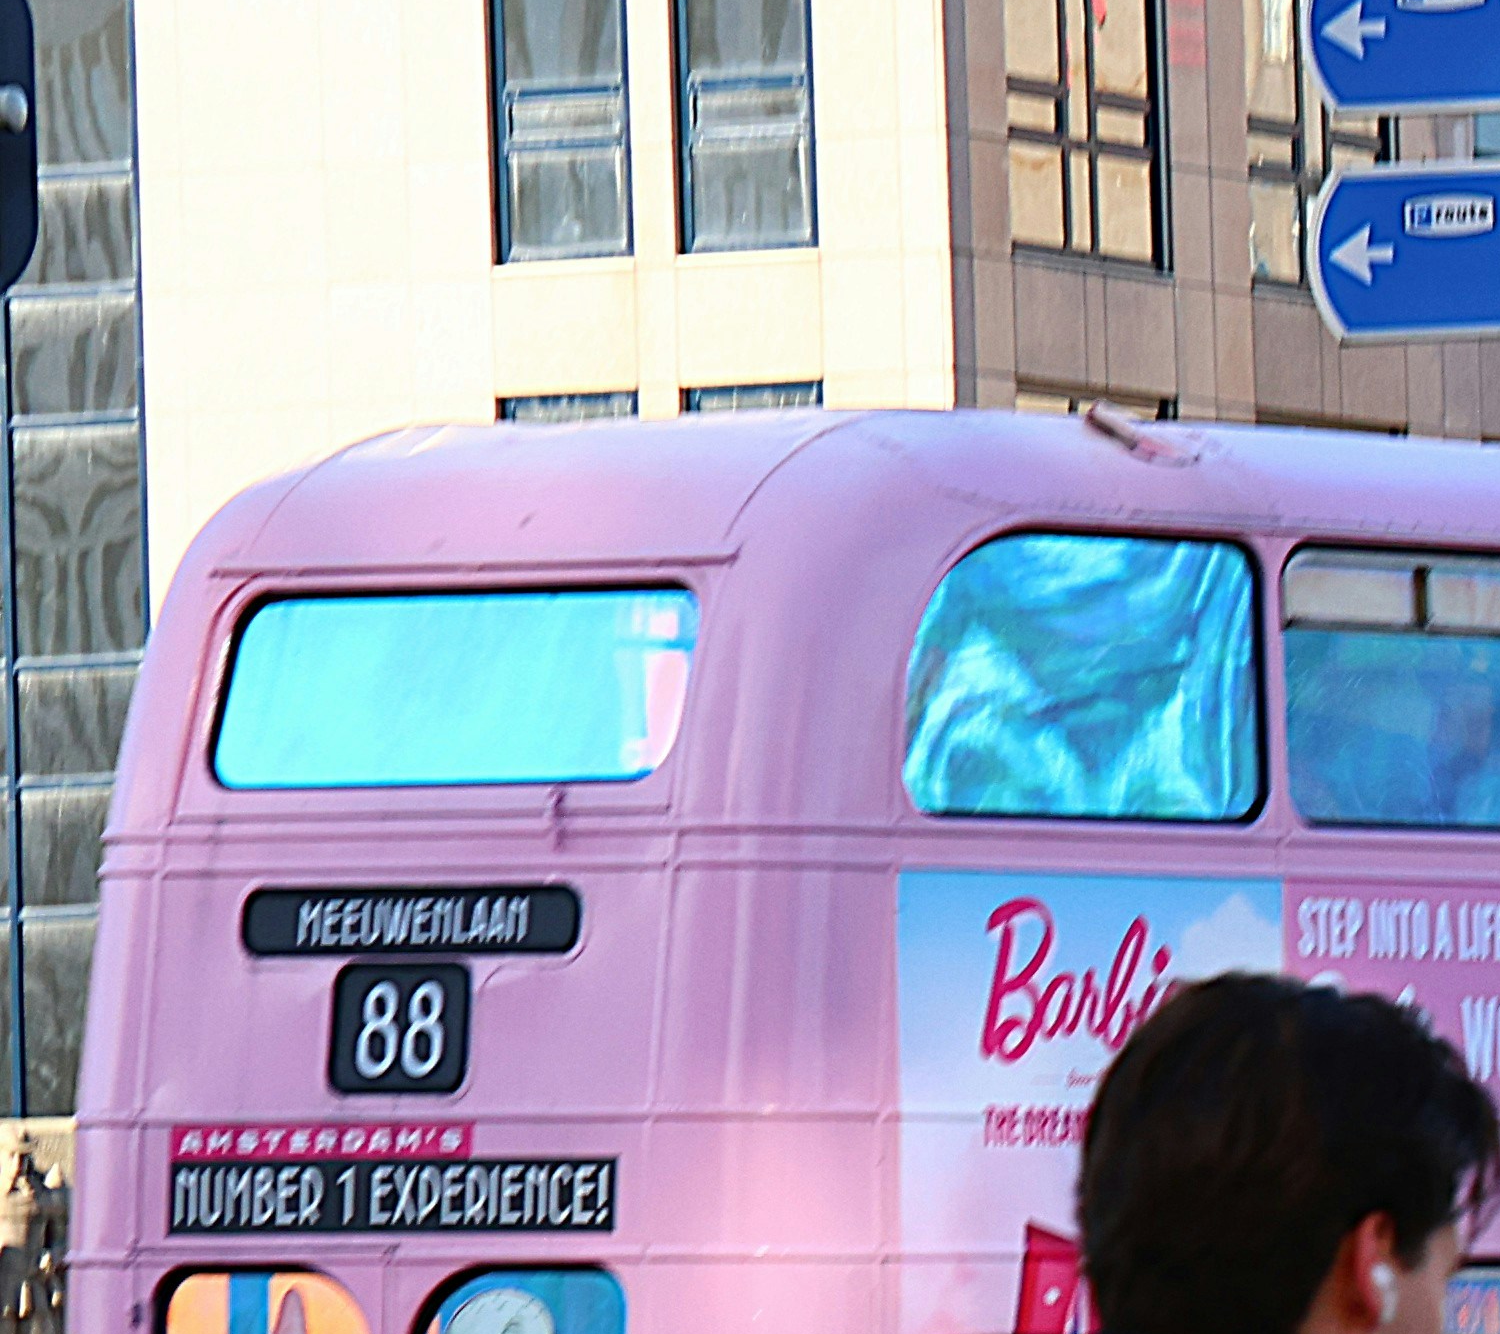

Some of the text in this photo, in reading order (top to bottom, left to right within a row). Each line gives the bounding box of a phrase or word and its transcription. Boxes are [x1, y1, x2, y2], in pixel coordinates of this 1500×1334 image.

[296, 895, 530, 947] MEEUWENLAAN
[1298, 897, 1364, 959] STEP
[1368, 898, 1431, 961] INTO
[1434, 900, 1452, 962] A
[979, 896, 1180, 1067] Barbi
[354, 979, 445, 1080] 88
[174, 1163, 611, 1227] NUMBER 1 EXPERIENCE!
